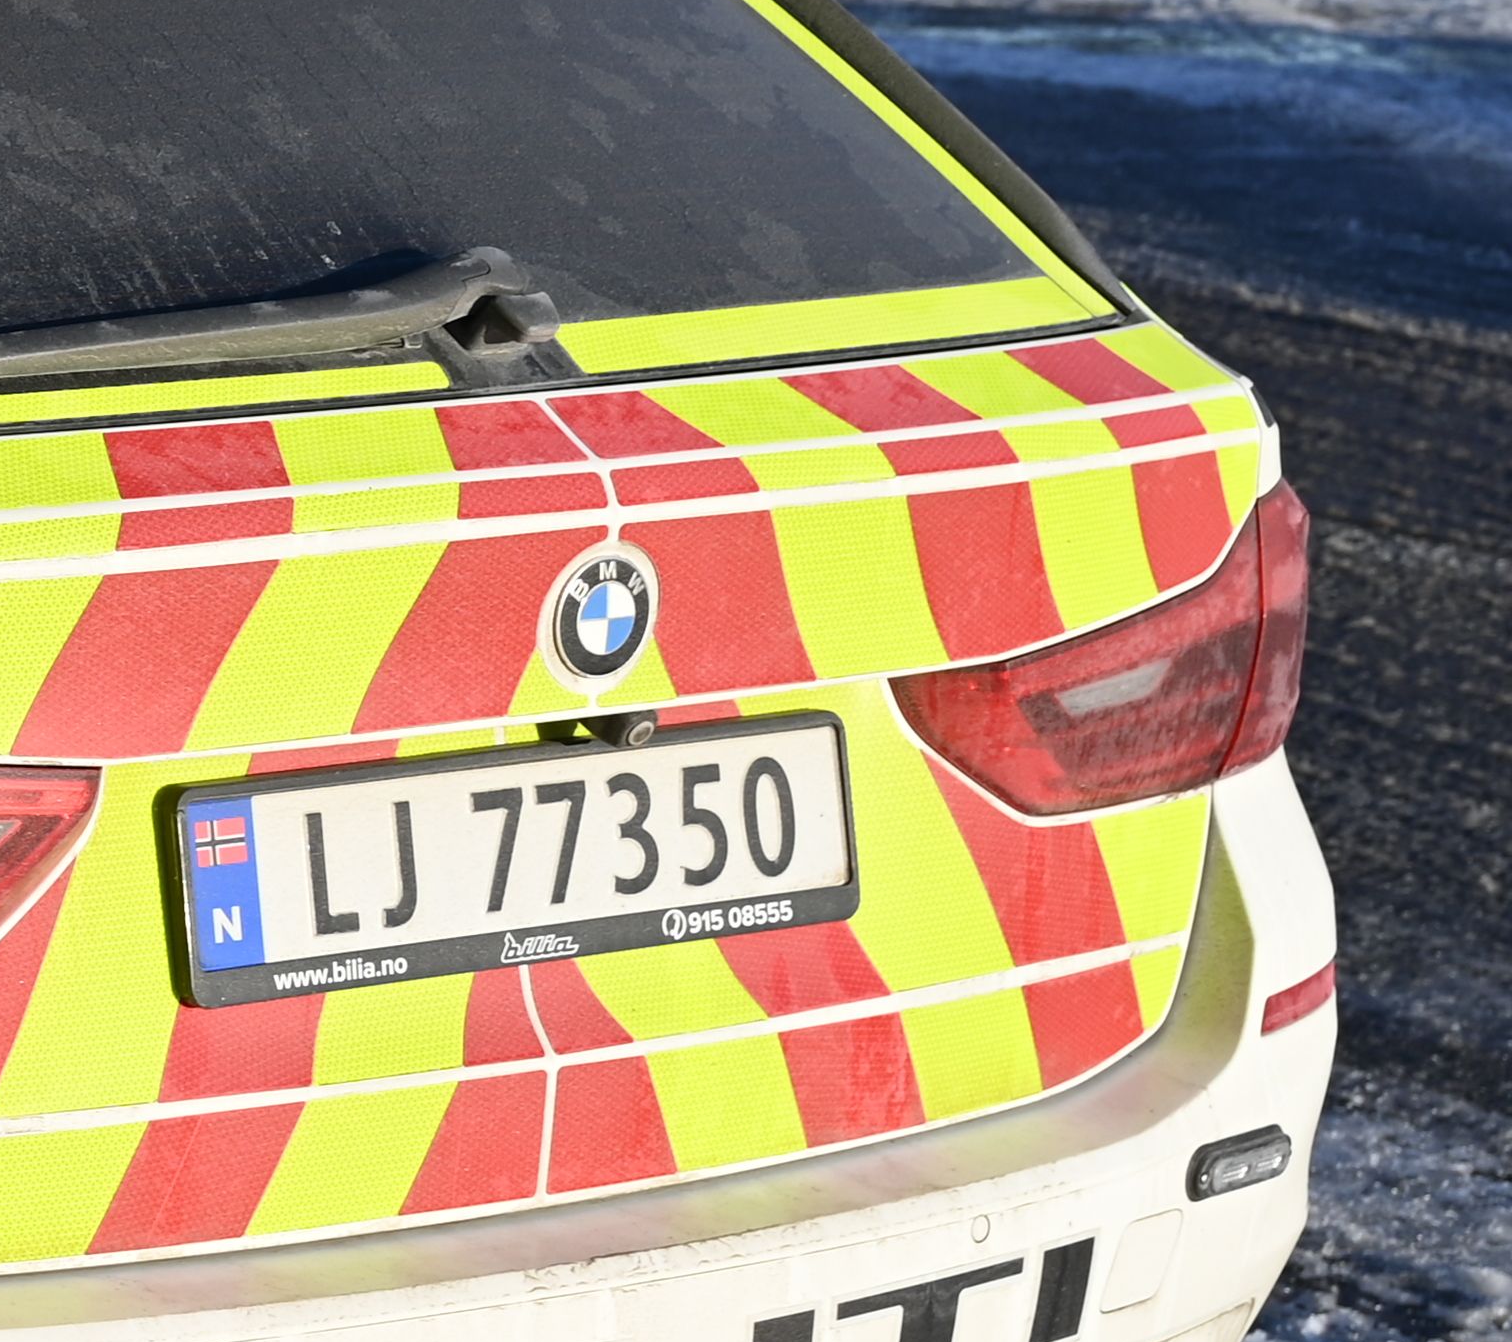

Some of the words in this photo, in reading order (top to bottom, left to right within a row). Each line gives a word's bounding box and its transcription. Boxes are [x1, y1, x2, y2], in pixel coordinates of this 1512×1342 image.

[565, 561, 646, 602] BMW
[304, 800, 417, 936] LJ
[470, 756, 795, 913] 77350
[212, 906, 243, 943] N
[689, 910, 724, 935] 915
[728, 900, 793, 928] 08555
[273, 956, 408, 990] www.bilia.no
